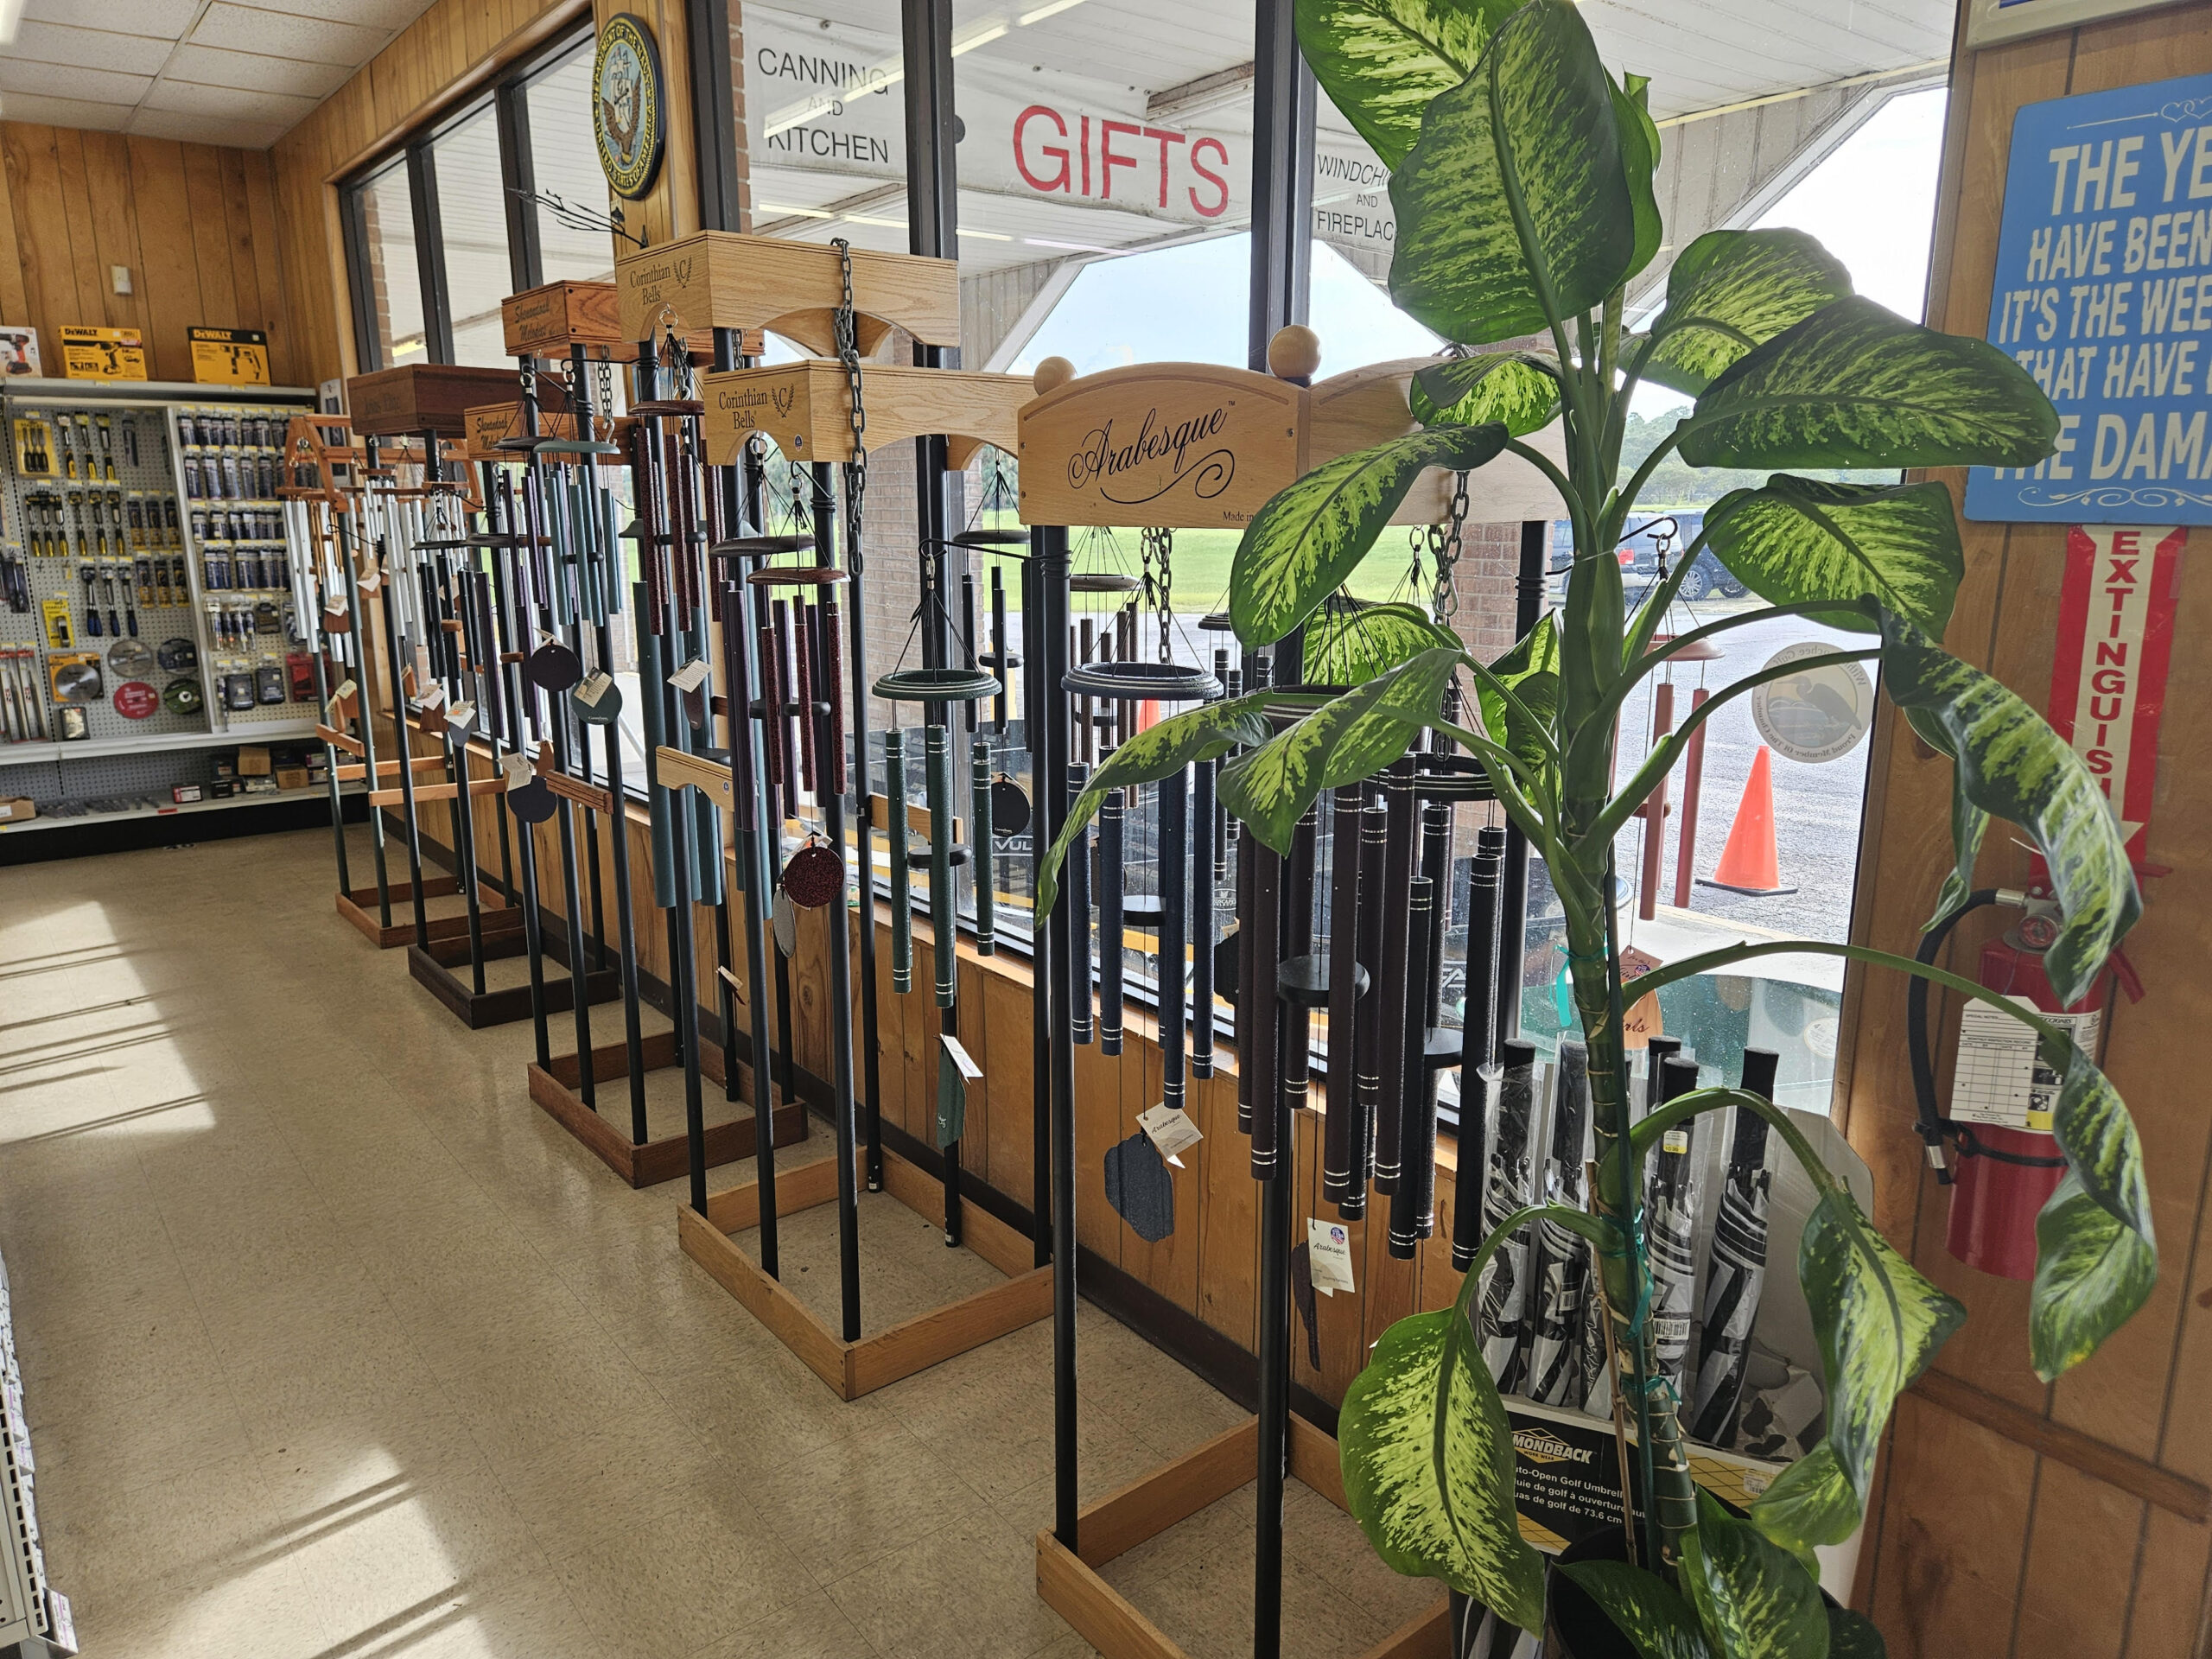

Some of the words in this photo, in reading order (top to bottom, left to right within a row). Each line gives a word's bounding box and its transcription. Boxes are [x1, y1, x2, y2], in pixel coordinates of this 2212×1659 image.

[758, 48, 888, 95] CANNING
[766, 123, 888, 163] KITCHEN
[1014, 105, 1229, 218] GIFTS
[2049, 136, 2145, 216] THE
[2160, 126, 2212, 203] YE
[1356, 194, 1378, 208] AND
[1318, 211, 1395, 241] FIREPLAC
[2026, 219, 2117, 283] HAVE
[2123, 208, 2212, 274] BEEN
[630, 263, 671, 288] Corinthian
[642, 285, 661, 305] Bells
[1999, 287, 2059, 344] IT'S
[2069, 281, 2133, 339] THE
[2141, 275, 2212, 335] WEE
[2015, 346, 2097, 401] THAT
[2103, 340, 2199, 398] HAVE
[719, 388, 767, 410] Corinthian
[733, 410, 755, 429] Bells
[1068, 408, 1228, 489] Arabesque
[1223, 511, 1244, 522] Made
[1151, 1114, 1181, 1134] Arabesque
[1313, 1243, 1346, 1255] Arabesque
[1560, 1476, 1582, 1488] Golf
[1533, 1495, 1545, 1504] de
[1548, 1500, 1567, 1510] golf
[1569, 1504, 1581, 1514] de
[1585, 1508, 1605, 1520] 73.6
[1606, 1515, 1622, 1524] cm
[1534, 1483, 1546, 1492] de
[1548, 1487, 1568, 1497] golf
[1569, 1491, 1576, 1500] à
[1579, 1496, 1624, 1512] ouverture
